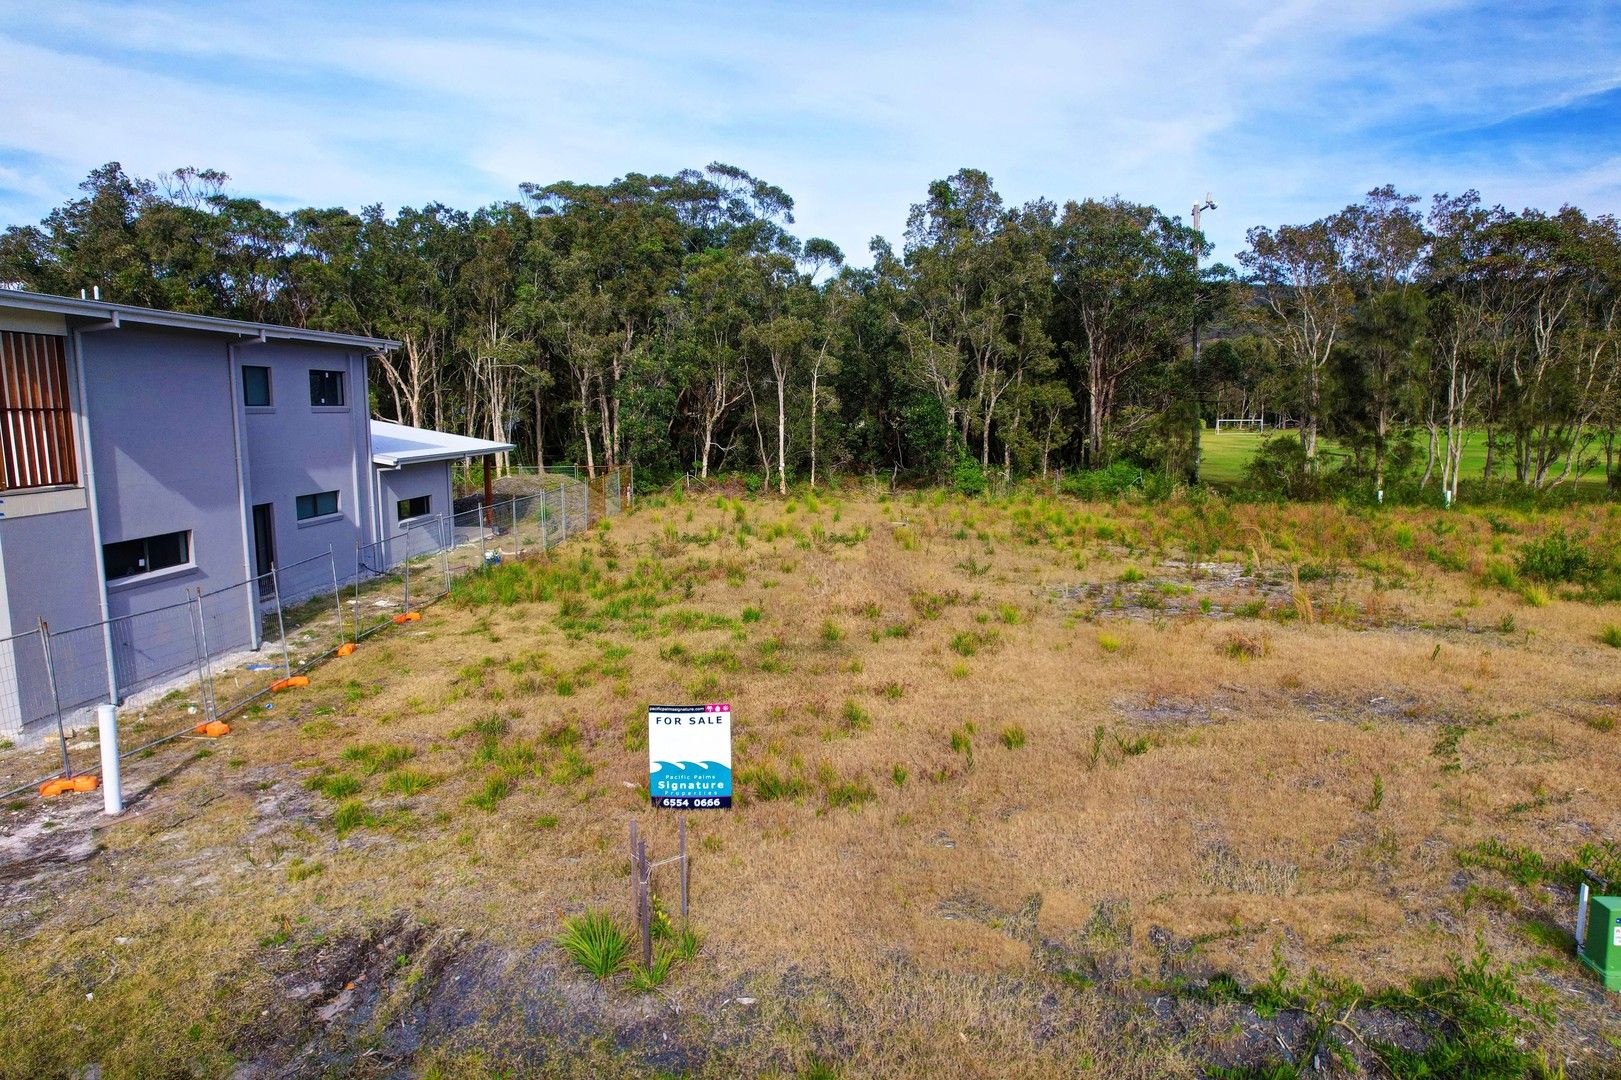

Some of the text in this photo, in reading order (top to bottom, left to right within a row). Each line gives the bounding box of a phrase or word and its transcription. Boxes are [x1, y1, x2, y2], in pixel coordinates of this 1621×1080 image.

[656, 716, 723, 725] FOR SALE
[658, 780, 724, 791] Signature
[663, 798, 720, 807] 6554 0666
